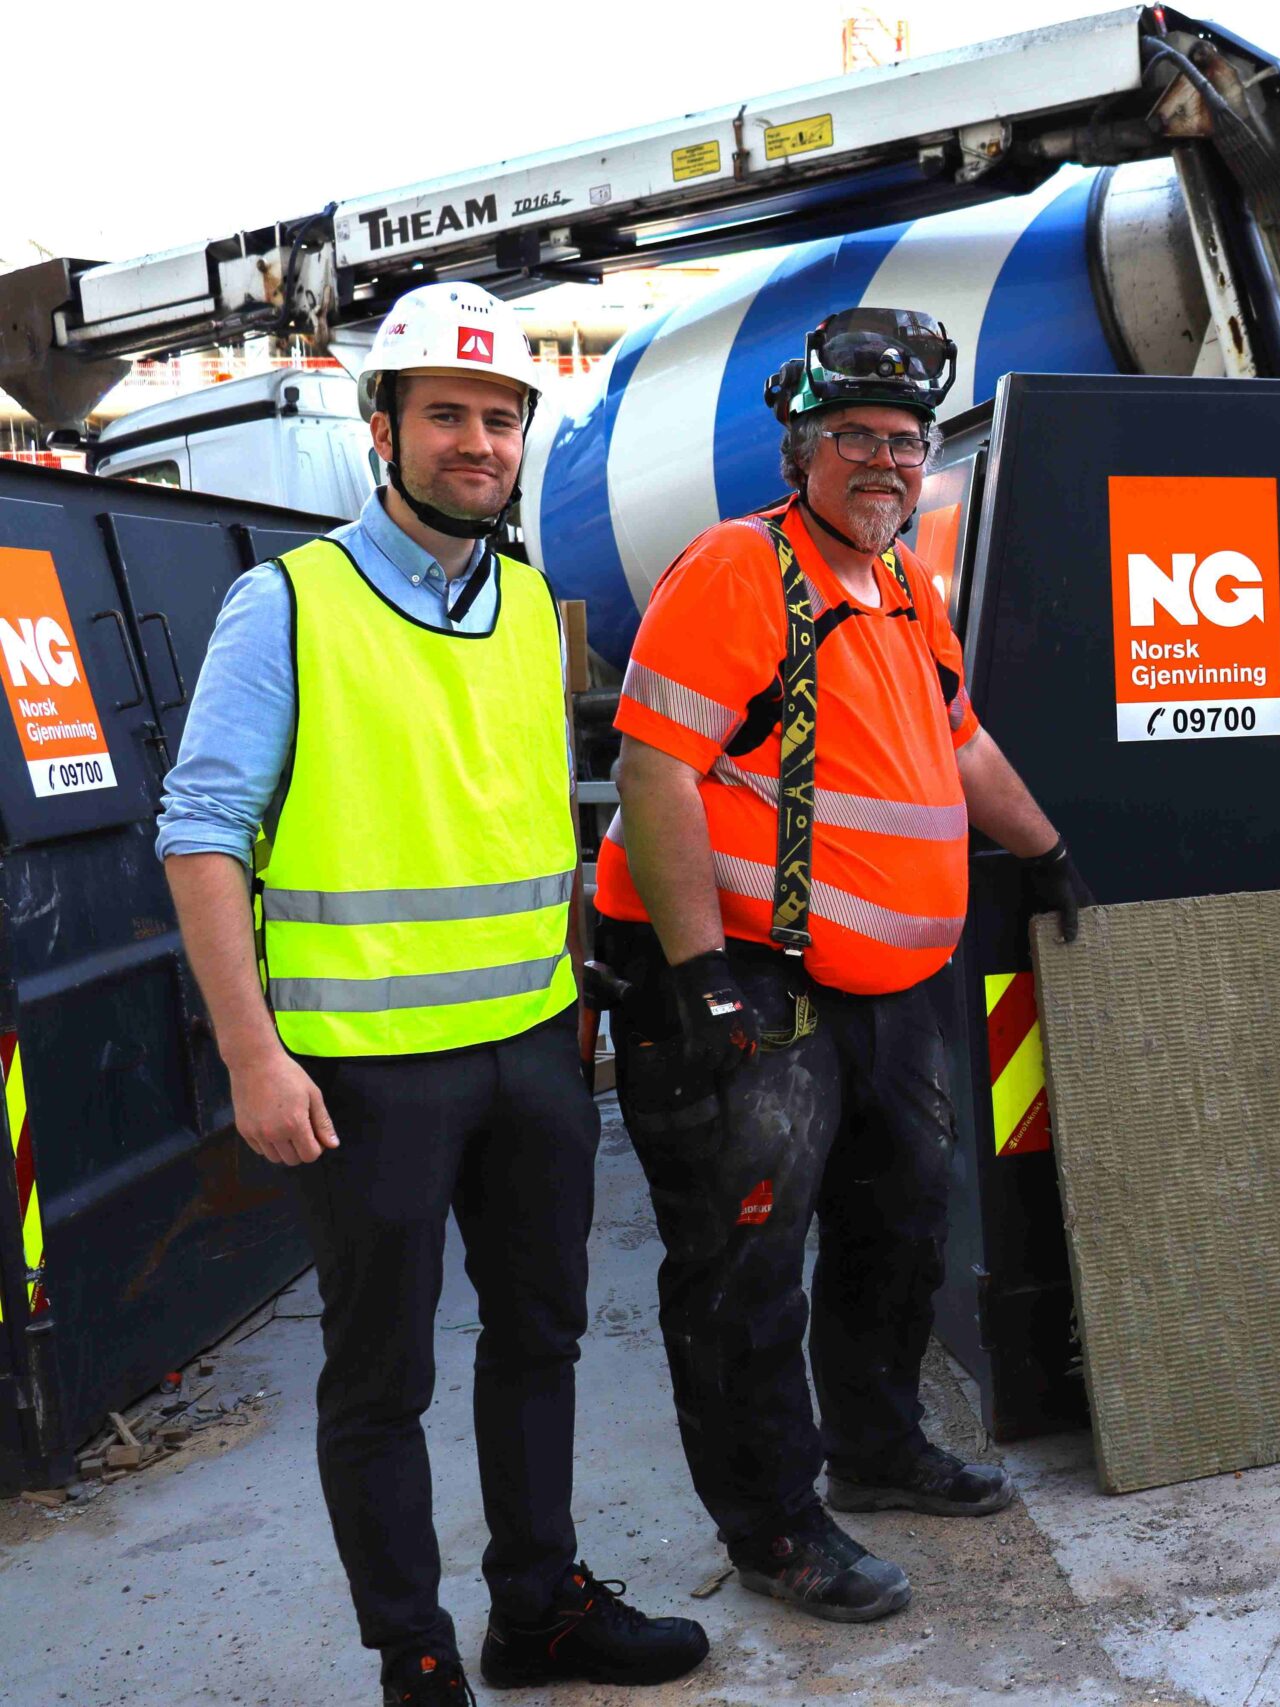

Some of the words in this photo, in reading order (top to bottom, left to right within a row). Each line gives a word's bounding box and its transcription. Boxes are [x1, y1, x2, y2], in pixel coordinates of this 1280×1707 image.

[514, 190, 562, 213] TD16.5
[358, 193, 498, 251] THEAM
[1127, 550, 1265, 628] NG
[0, 616, 81, 687] NG
[1130, 639, 1200, 660] Norsk
[1131, 663, 1267, 690] Gjenvinning
[18, 698, 59, 718] Norsk
[1172, 706, 1257, 734] 09700
[26, 720, 97, 745] Gjenvinning
[59, 760, 104, 788] 09700
